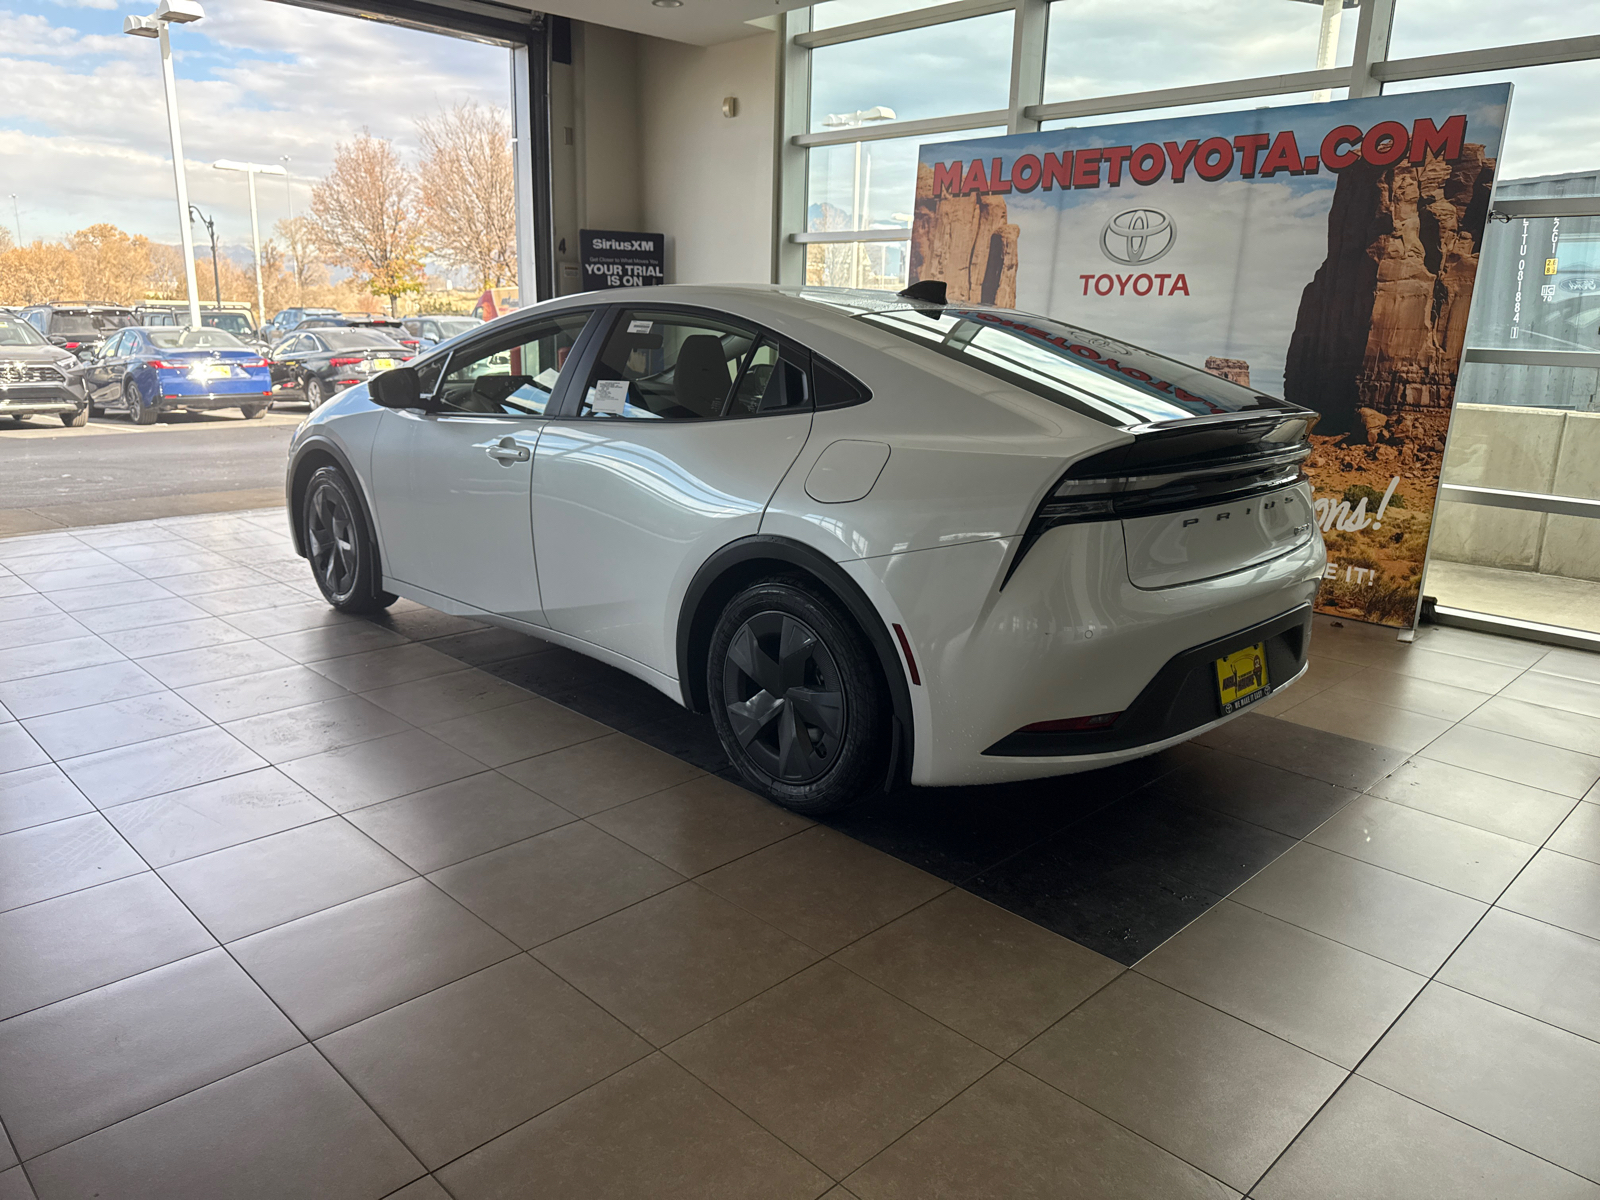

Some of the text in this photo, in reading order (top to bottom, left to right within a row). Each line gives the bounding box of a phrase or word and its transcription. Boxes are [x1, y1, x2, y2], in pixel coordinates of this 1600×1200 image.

[931, 115, 1467, 199] MALONETOYOTA.COM
[592, 238, 654, 252] SiriusXM
[585, 264, 622, 275] YOUR
[624, 265, 663, 277] TRIAL
[607, 275, 643, 286] IS ON
[1079, 272, 1190, 298] TOYOTA
[1513, 260, 1525, 323] 081884
[1182, 496, 1294, 528] PRIUS
[1345, 566, 1376, 587] IT!
